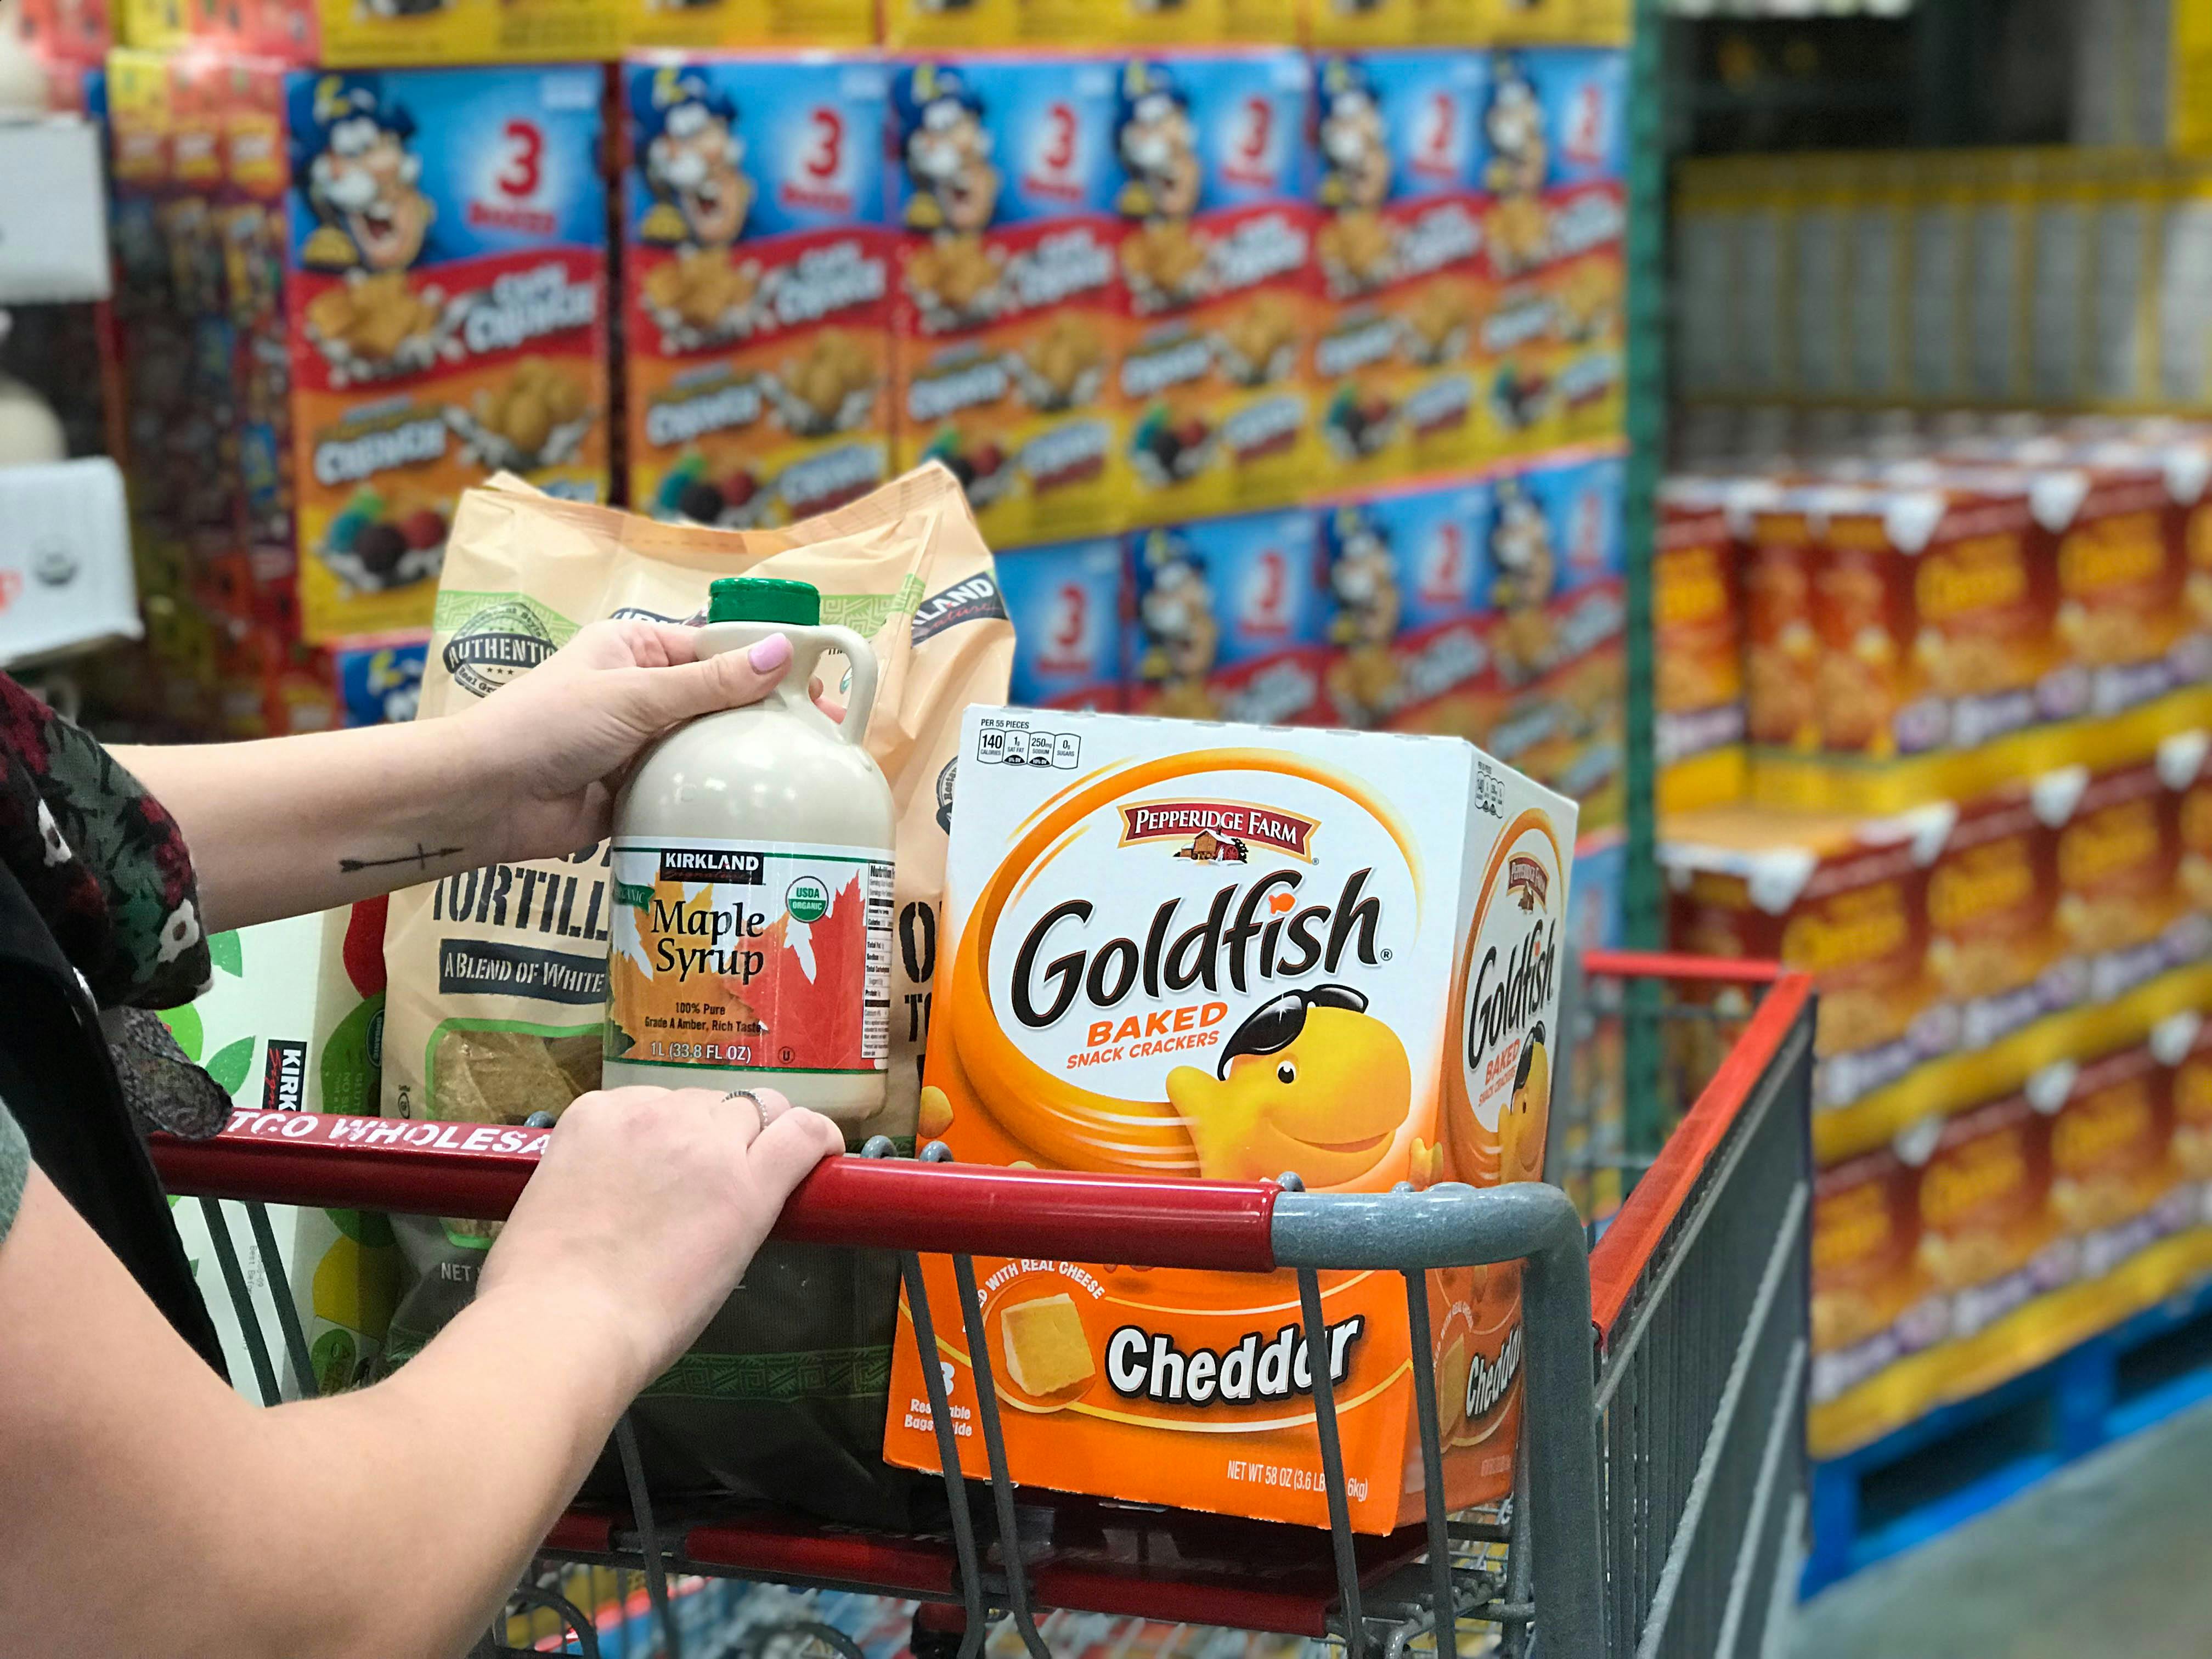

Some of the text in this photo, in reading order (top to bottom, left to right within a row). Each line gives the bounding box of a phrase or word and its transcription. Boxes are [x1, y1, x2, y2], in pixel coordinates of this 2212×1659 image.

[498, 120, 543, 198] 3
[806, 110, 843, 180] 3
[982, 734, 1003, 749] 140
[1006, 720, 1030, 729] PIECES
[1031, 737, 1052, 749] 250mg
[944, 766, 957, 800] Resta
[1135, 809, 1297, 845] PEPPERIDGE FARM
[665, 853, 759, 871] KIRKLAND
[792, 901, 822, 911] ORGANIC
[797, 887, 820, 899] USDA
[652, 899, 765, 946] Maple
[657, 938, 764, 985] Syrup
[1011, 867, 1381, 1028] Goldfish
[444, 951, 606, 992] A BLEND OF WHITE
[676, 1002, 726, 1015] 100% Pure
[1468, 917, 1556, 1070] Goldfish
[645, 1016, 761, 1033] Grade A Amber, Rich Taste
[1087, 1001, 1228, 1048] BAKED
[669, 1042, 702, 1060] (33.8
[706, 1045, 723, 1060] FL
[726, 1045, 752, 1064] OZ)
[1066, 1030, 1220, 1069] SNACK CRACKERS
[1485, 1038, 1520, 1086] BAKED
[278, 1049, 301, 1111] KIRK
[227, 1111, 551, 1155] TCO WHOLESA
[441, 1262, 471, 1282] NET
[985, 1259, 1105, 1300] WITH REAL CHEESE
[905, 1413, 934, 1431] Bags
[910, 1398, 971, 1420] Resble
[1227, 1460, 1246, 1480] NET
[1249, 1463, 1263, 1483] WT
[1265, 1466, 1278, 1485] 58
[1279, 1468, 1293, 1487] OZ
[1294, 1468, 1312, 1491] (3.6
